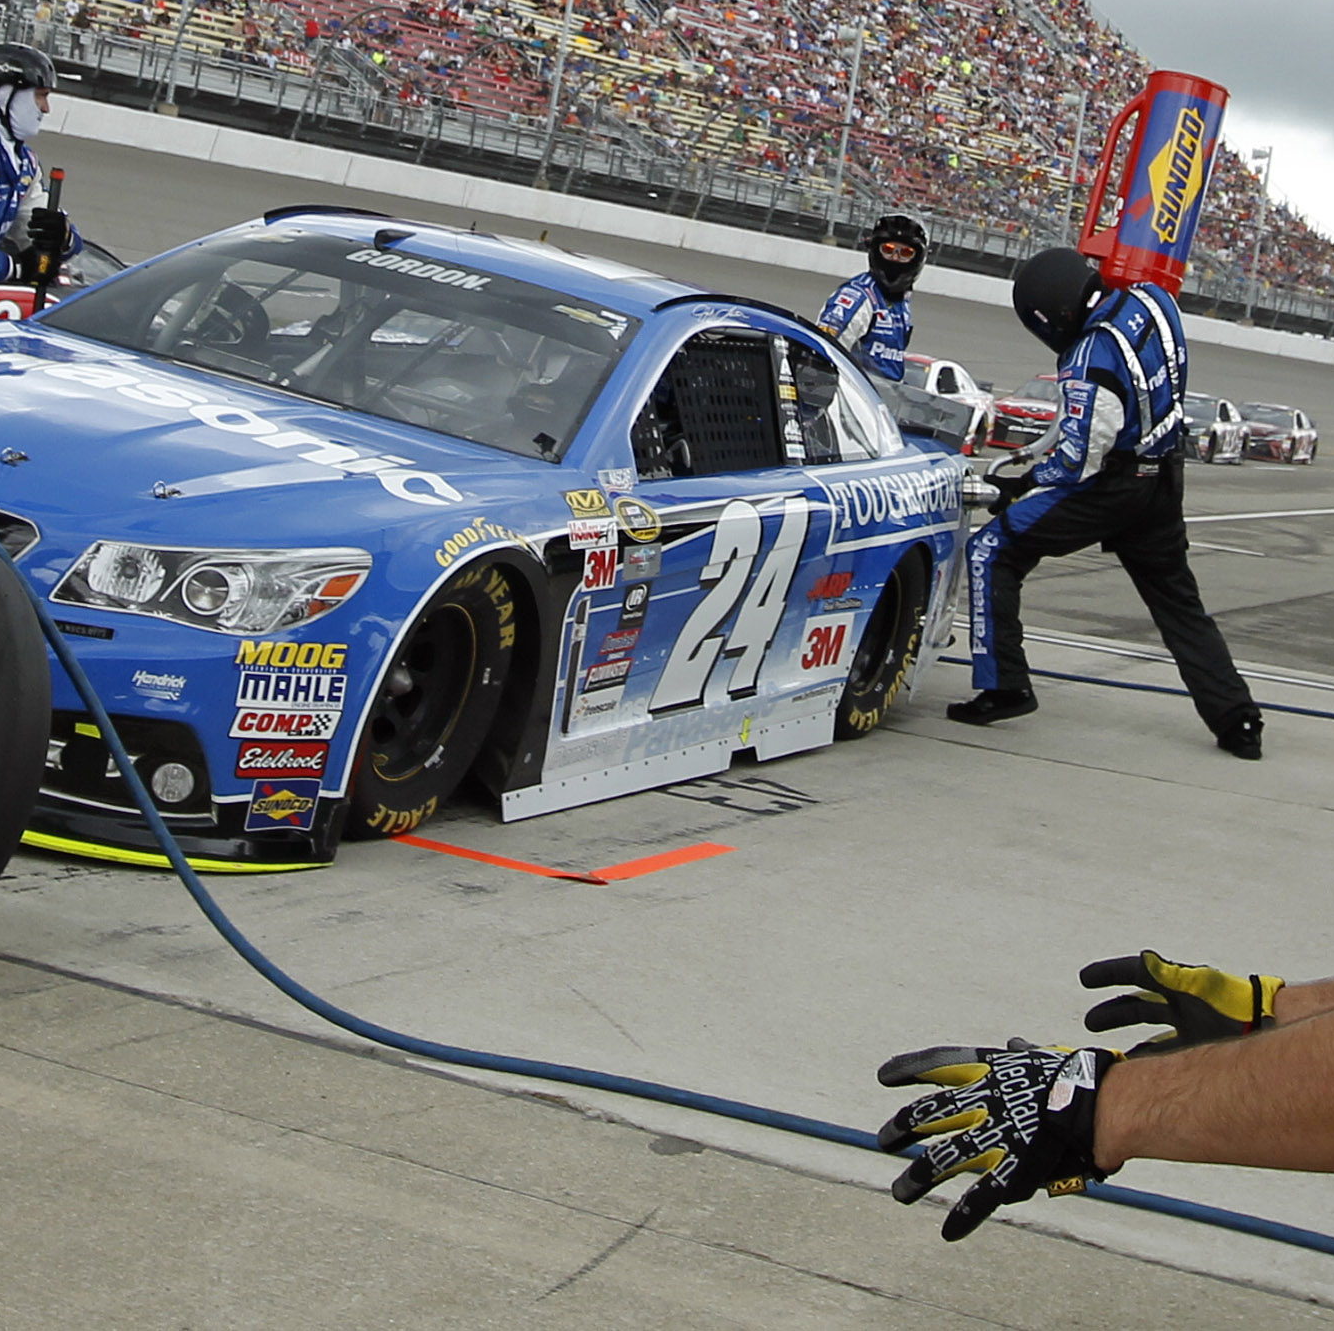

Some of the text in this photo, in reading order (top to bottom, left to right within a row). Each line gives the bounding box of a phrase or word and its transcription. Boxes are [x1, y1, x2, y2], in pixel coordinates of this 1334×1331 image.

[1156, 112, 1204, 240] SUNOCO
[829, 466, 960, 529] TOUGHBOOK
[584, 548, 617, 588] 3M
[647, 497, 809, 715] 24
[971, 530, 999, 655] Panasonic
[234, 640, 348, 668] MOOG
[801, 624, 847, 670] 3M
[131, 669, 187, 689] Hendrick
[240, 672, 345, 703] MAHLE
[238, 711, 314, 733] COMP
[238, 747, 324, 770] Edelbrock
[253, 797, 312, 813] SUNOCO
[367, 794, 439, 835] EAGLE
